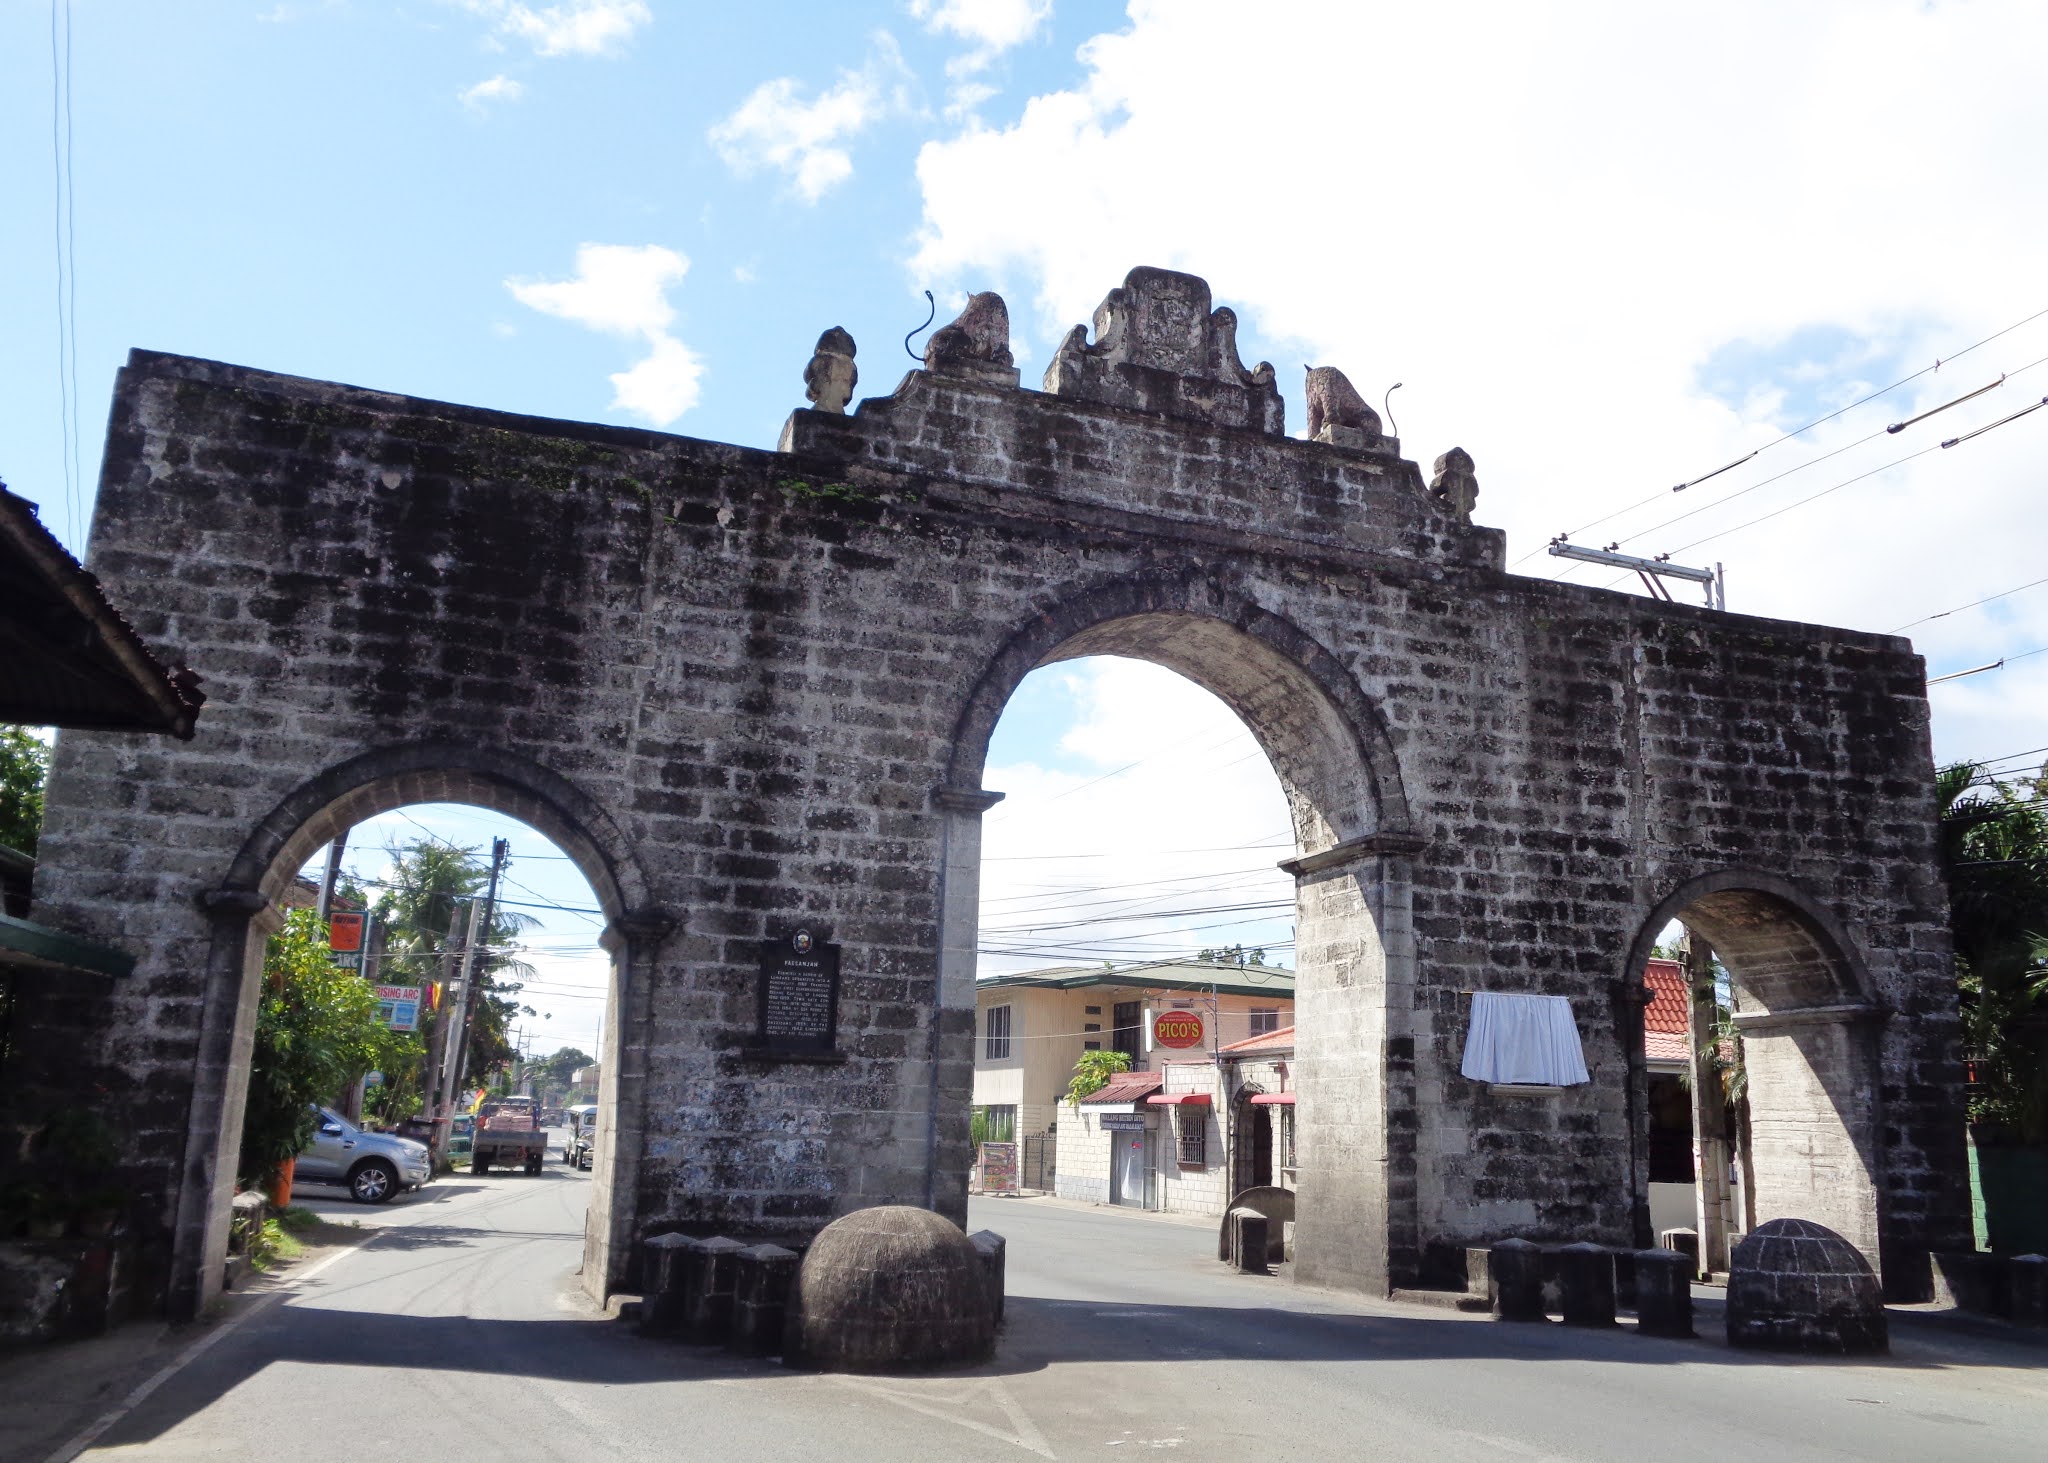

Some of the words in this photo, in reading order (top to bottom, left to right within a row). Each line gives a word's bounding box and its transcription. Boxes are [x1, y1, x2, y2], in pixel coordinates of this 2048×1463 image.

[375, 986, 401, 999] RISING
[402, 988, 419, 1000] ARC
[1158, 1022, 1200, 1038] PICO'S
